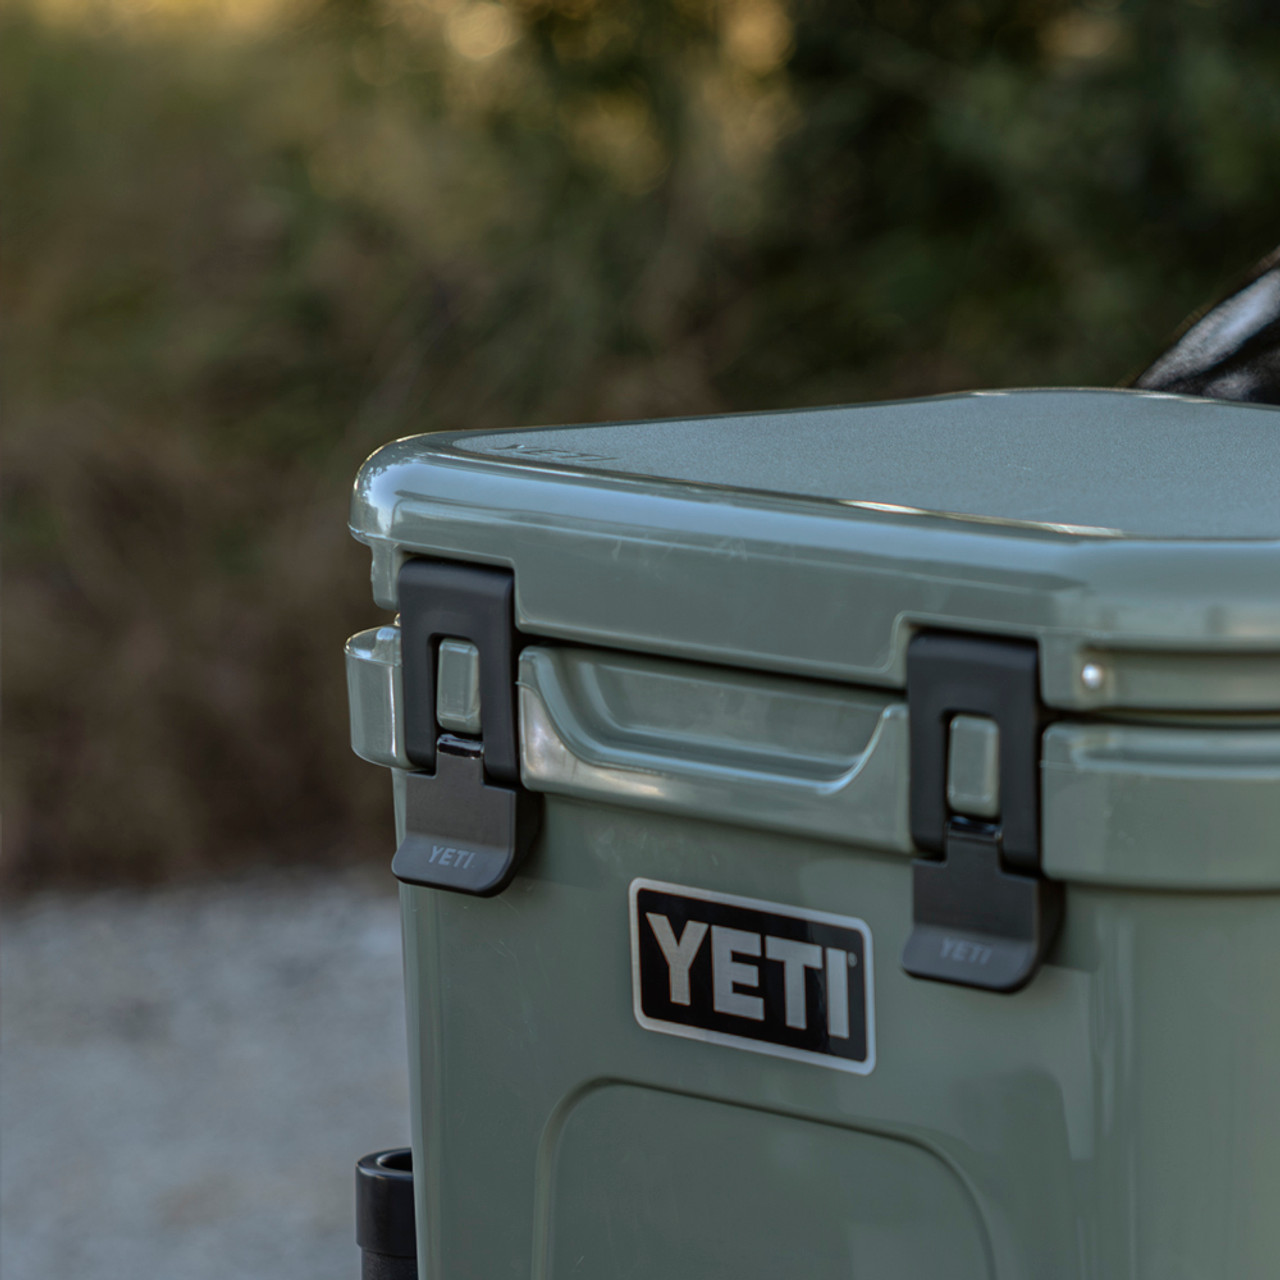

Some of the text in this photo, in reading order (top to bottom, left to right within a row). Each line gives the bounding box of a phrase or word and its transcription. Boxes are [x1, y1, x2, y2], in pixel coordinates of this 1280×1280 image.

[428, 845, 476, 870] YETI
[940, 937, 992, 965] YETI
[645, 912, 850, 1040] YETI
